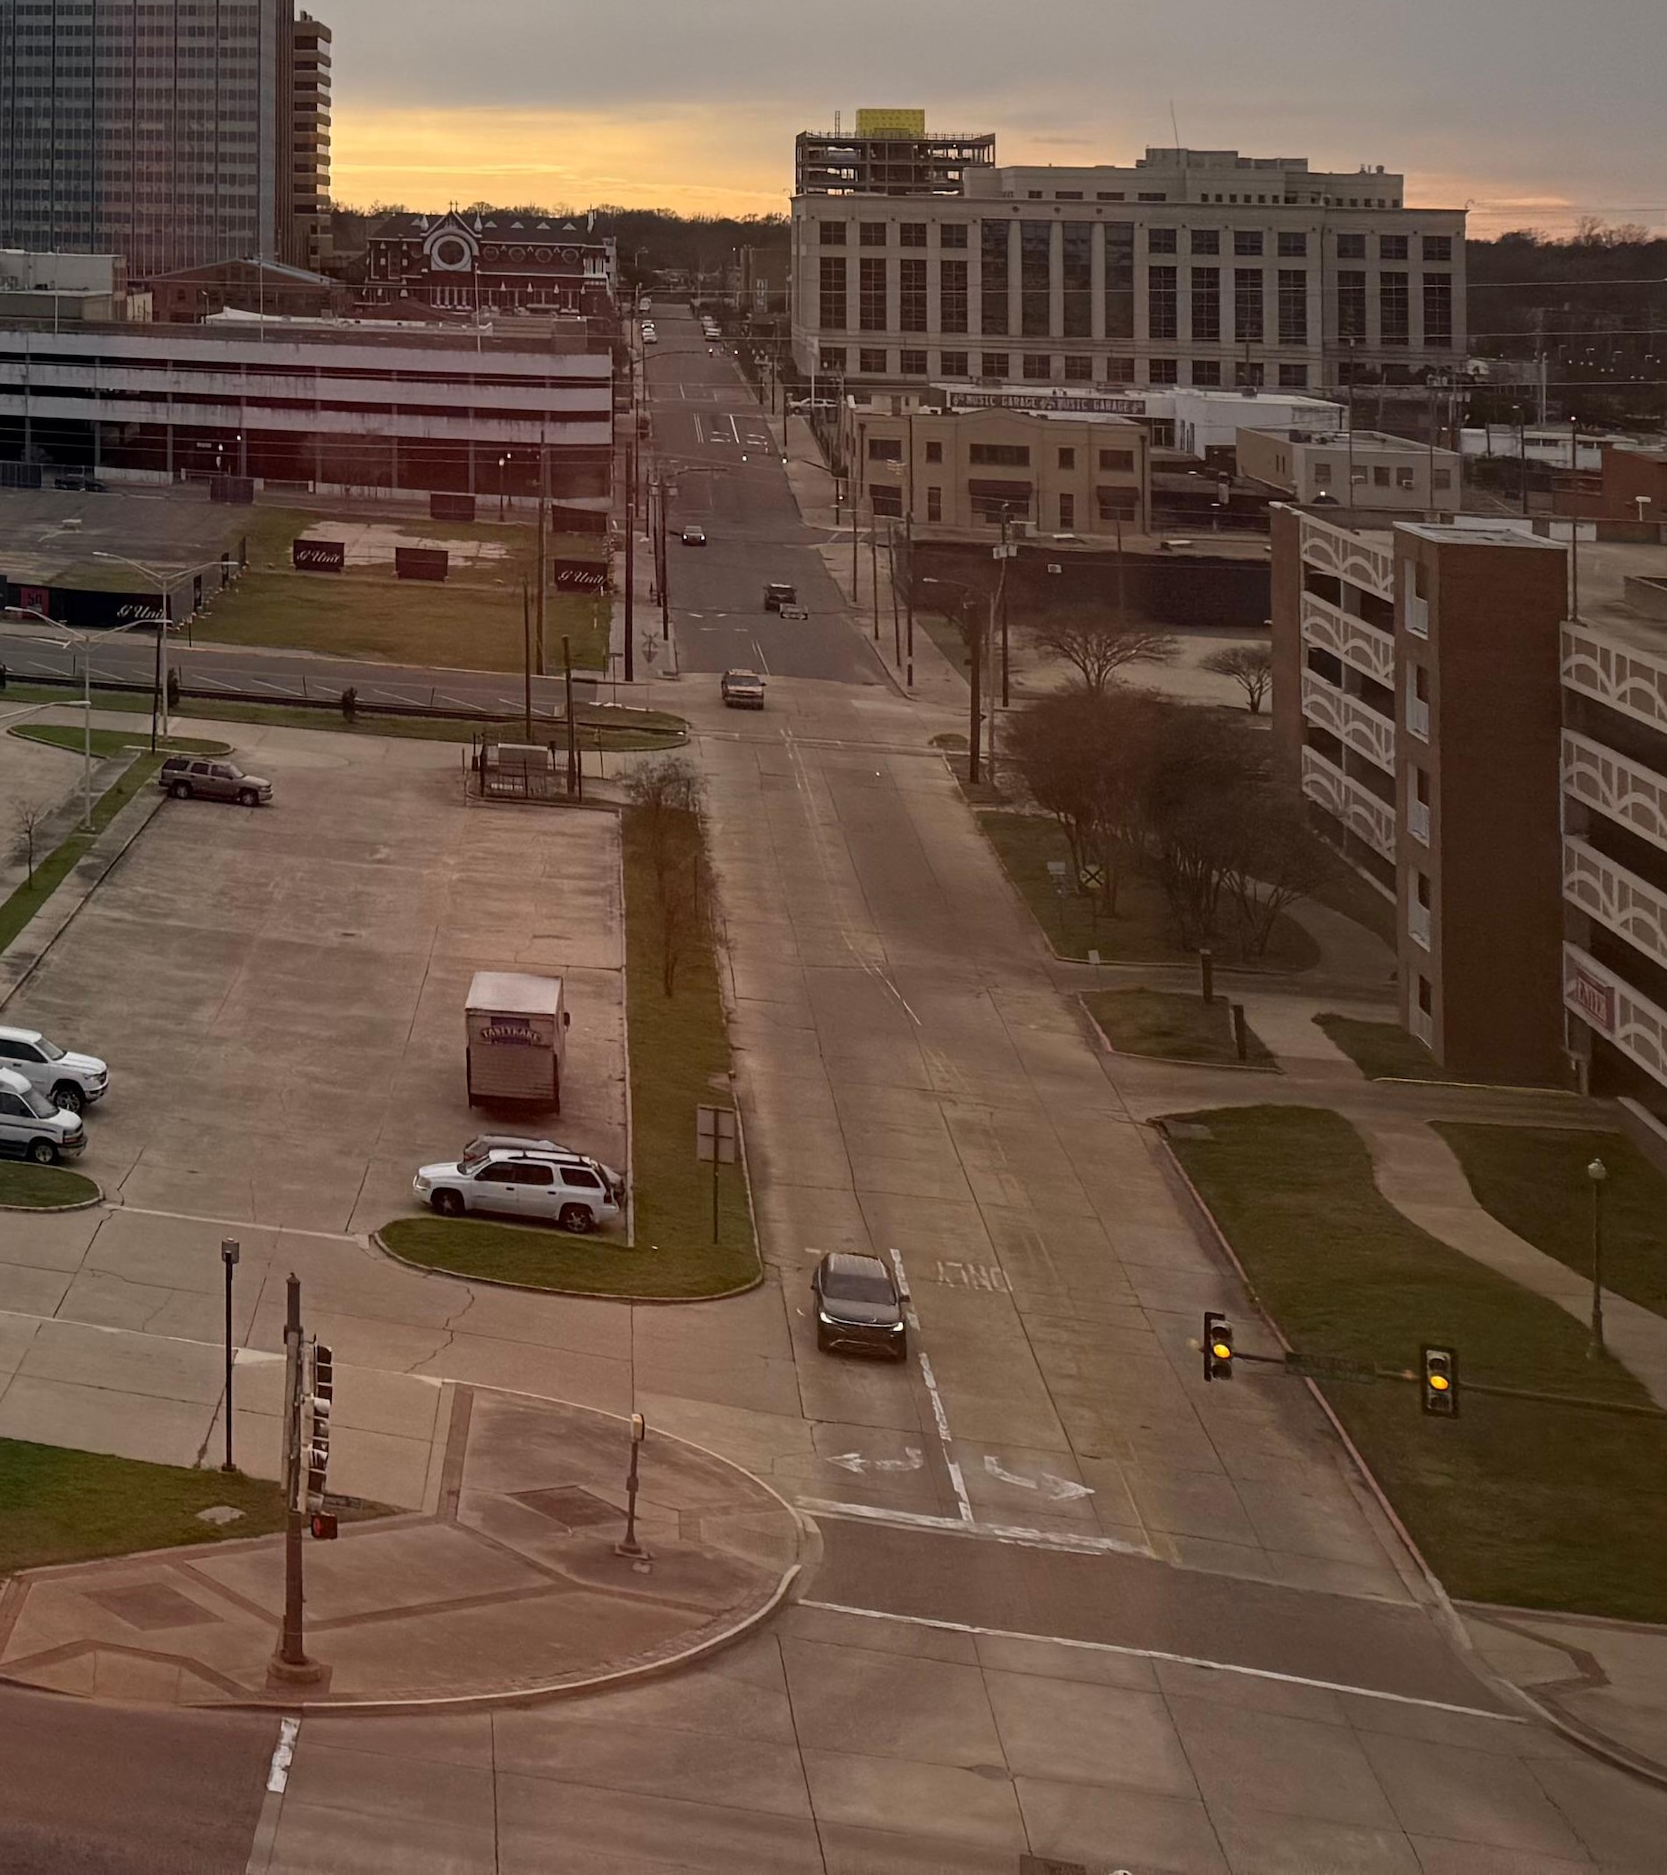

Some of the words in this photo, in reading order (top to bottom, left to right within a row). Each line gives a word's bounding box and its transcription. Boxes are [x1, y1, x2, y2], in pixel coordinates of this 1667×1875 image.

[966, 395, 996, 406] MUSIC
[1002, 397, 1037, 408] GARAGE
[1057, 399, 1088, 410] MUSIC
[1094, 400, 1129, 412] GARAGE
[937, 1261, 1013, 1293] ONLY
